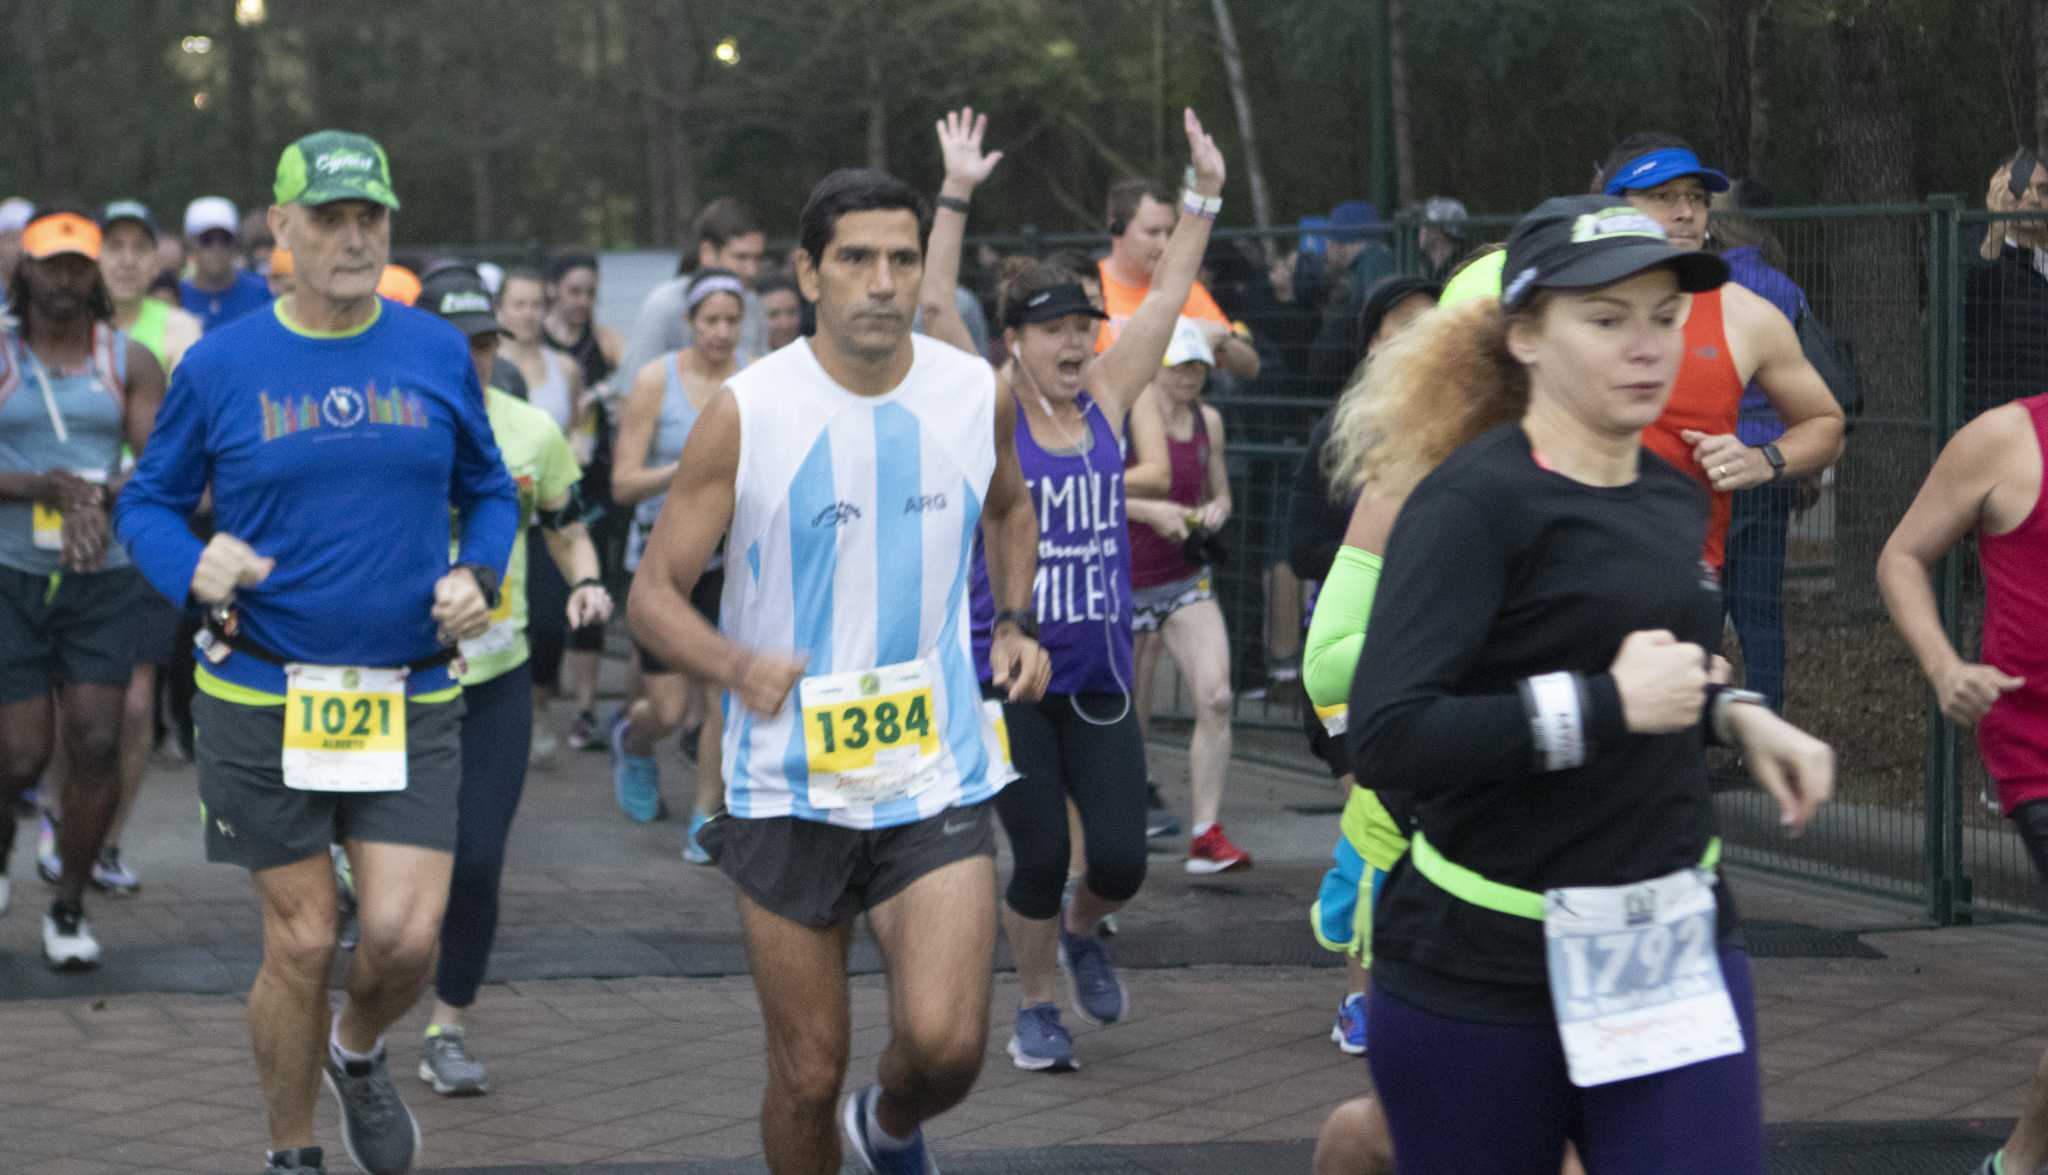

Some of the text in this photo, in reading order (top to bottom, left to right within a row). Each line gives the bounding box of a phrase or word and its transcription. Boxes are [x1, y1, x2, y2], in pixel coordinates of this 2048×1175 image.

[904, 493, 947, 515] ARG
[1025, 473, 1120, 533] MILE
[300, 695, 390, 736] 1021
[816, 695, 929, 753] 1384
[1561, 914, 1709, 1000] 1792
